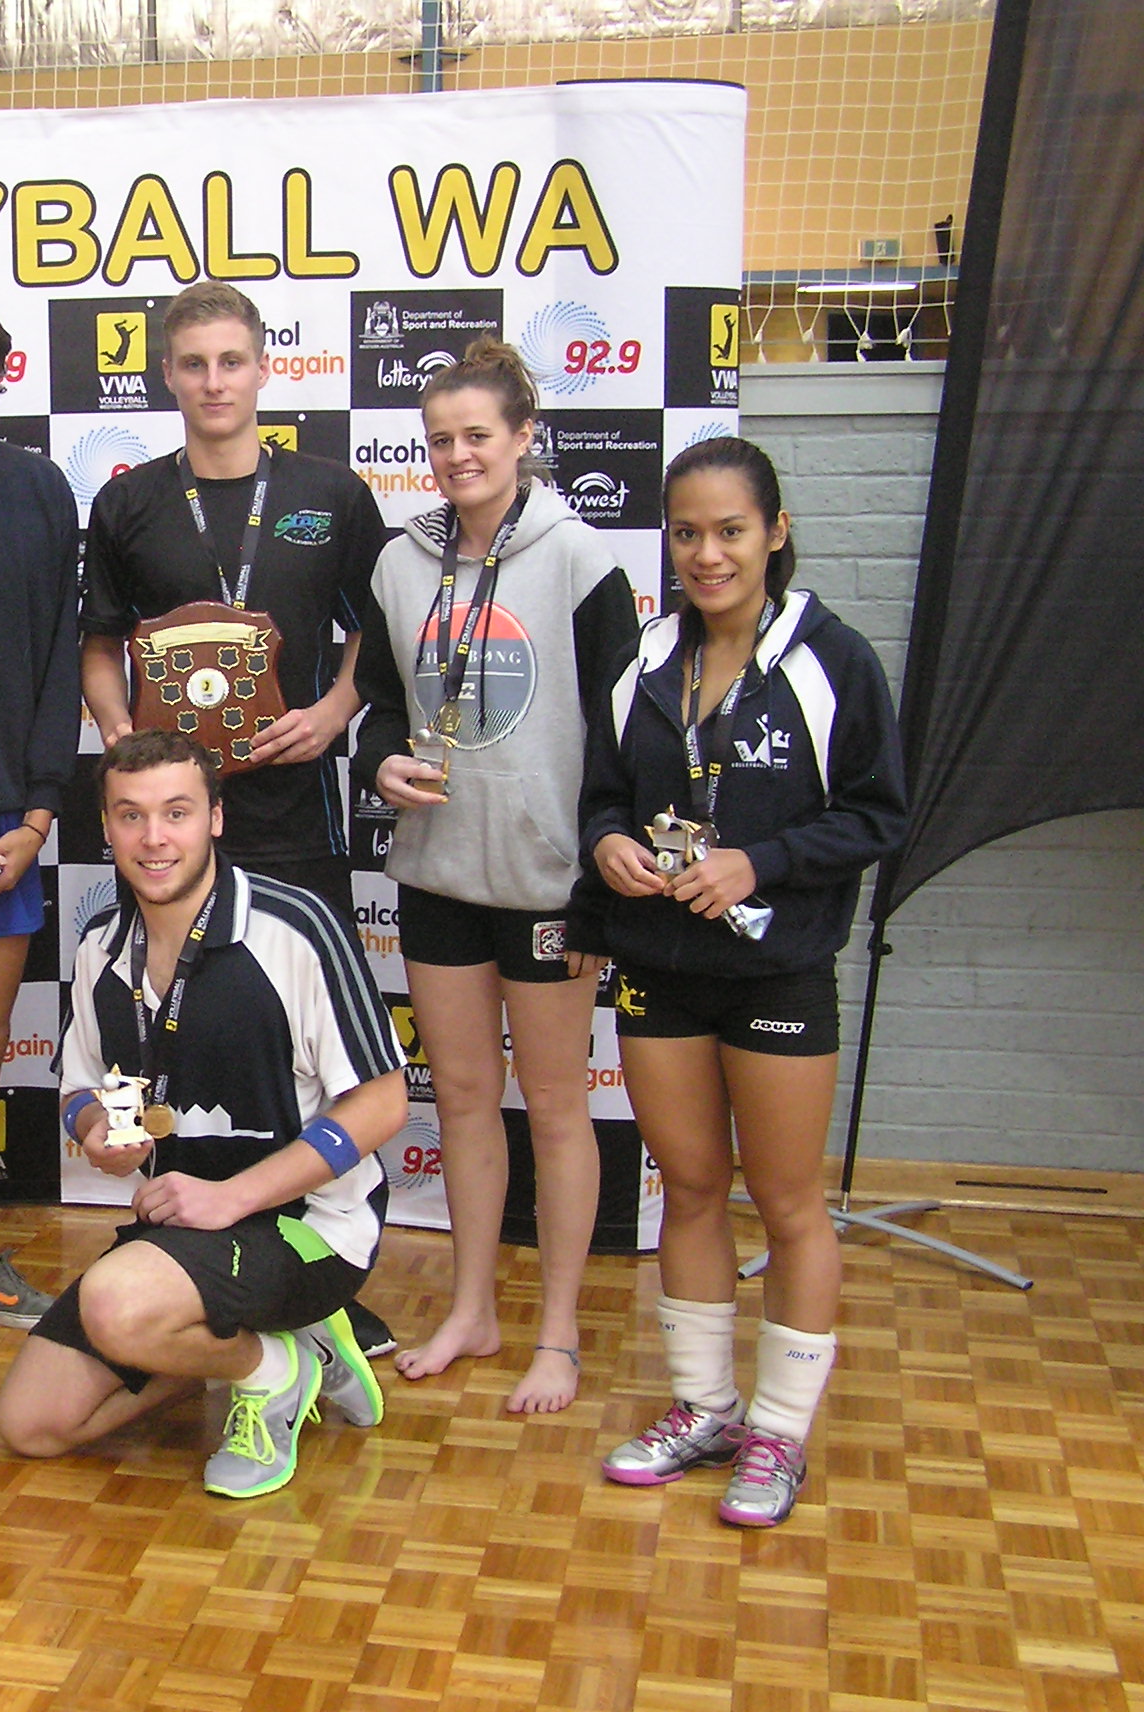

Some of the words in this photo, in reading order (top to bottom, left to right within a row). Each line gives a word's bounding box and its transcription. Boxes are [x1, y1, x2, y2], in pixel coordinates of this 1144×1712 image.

[389, 158, 619, 278] WA
[402, 311, 452, 320] Department
[453, 310, 462, 319] of
[402, 320, 427, 330] Sport
[429, 320, 447, 329] and
[448, 319, 498, 329] Recreation
[566, 340, 641, 375] 92.9
[99, 375, 147, 395] VWA
[557, 431, 609, 440] Department
[611, 430, 621, 439] of
[557, 441, 583, 451] Sport
[584, 440, 603, 450] and
[605, 440, 658, 450] Recreation
[749, 1018, 805, 1034] JOUST
